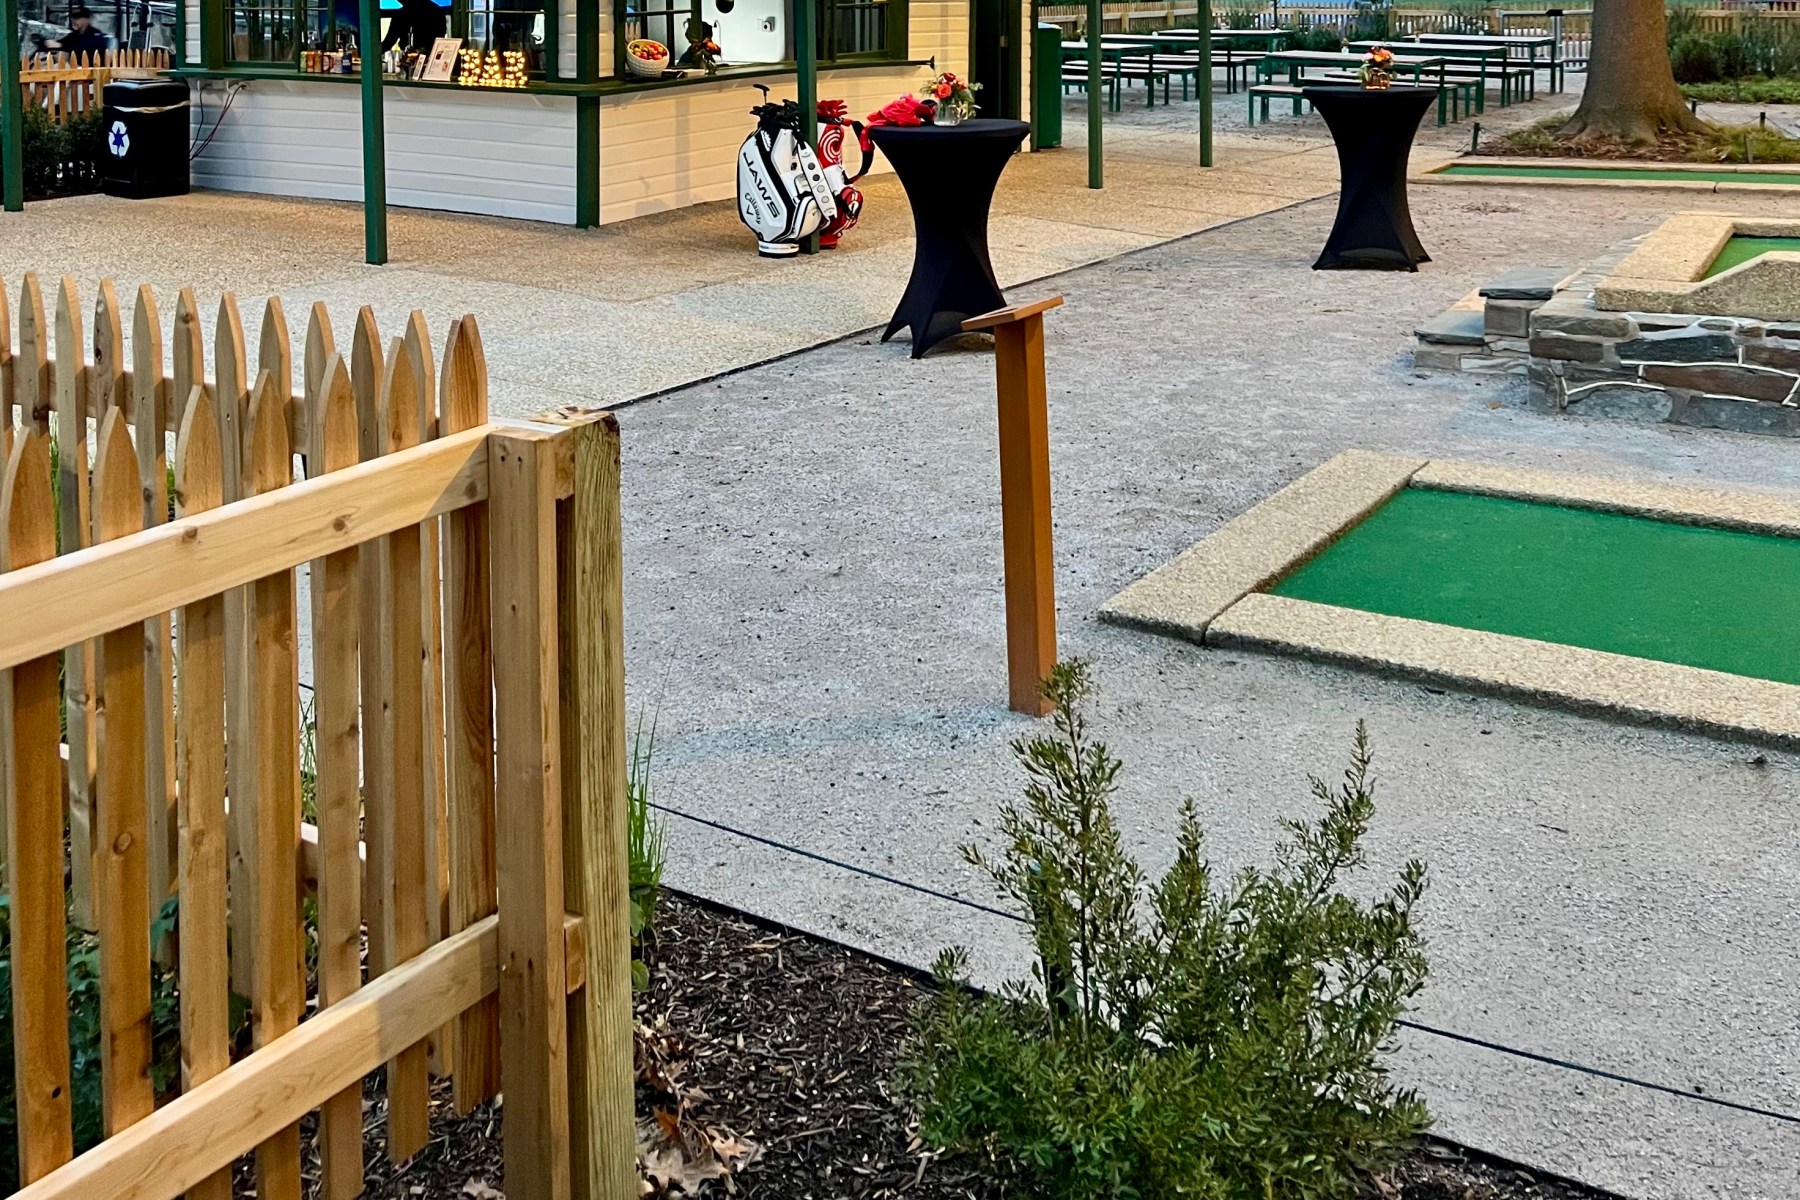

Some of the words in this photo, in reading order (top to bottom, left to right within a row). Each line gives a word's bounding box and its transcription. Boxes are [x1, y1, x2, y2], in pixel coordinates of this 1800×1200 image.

[459, 48, 528, 86] BAR
[743, 152, 780, 218] JAWS
[744, 192, 761, 224] Callaway
